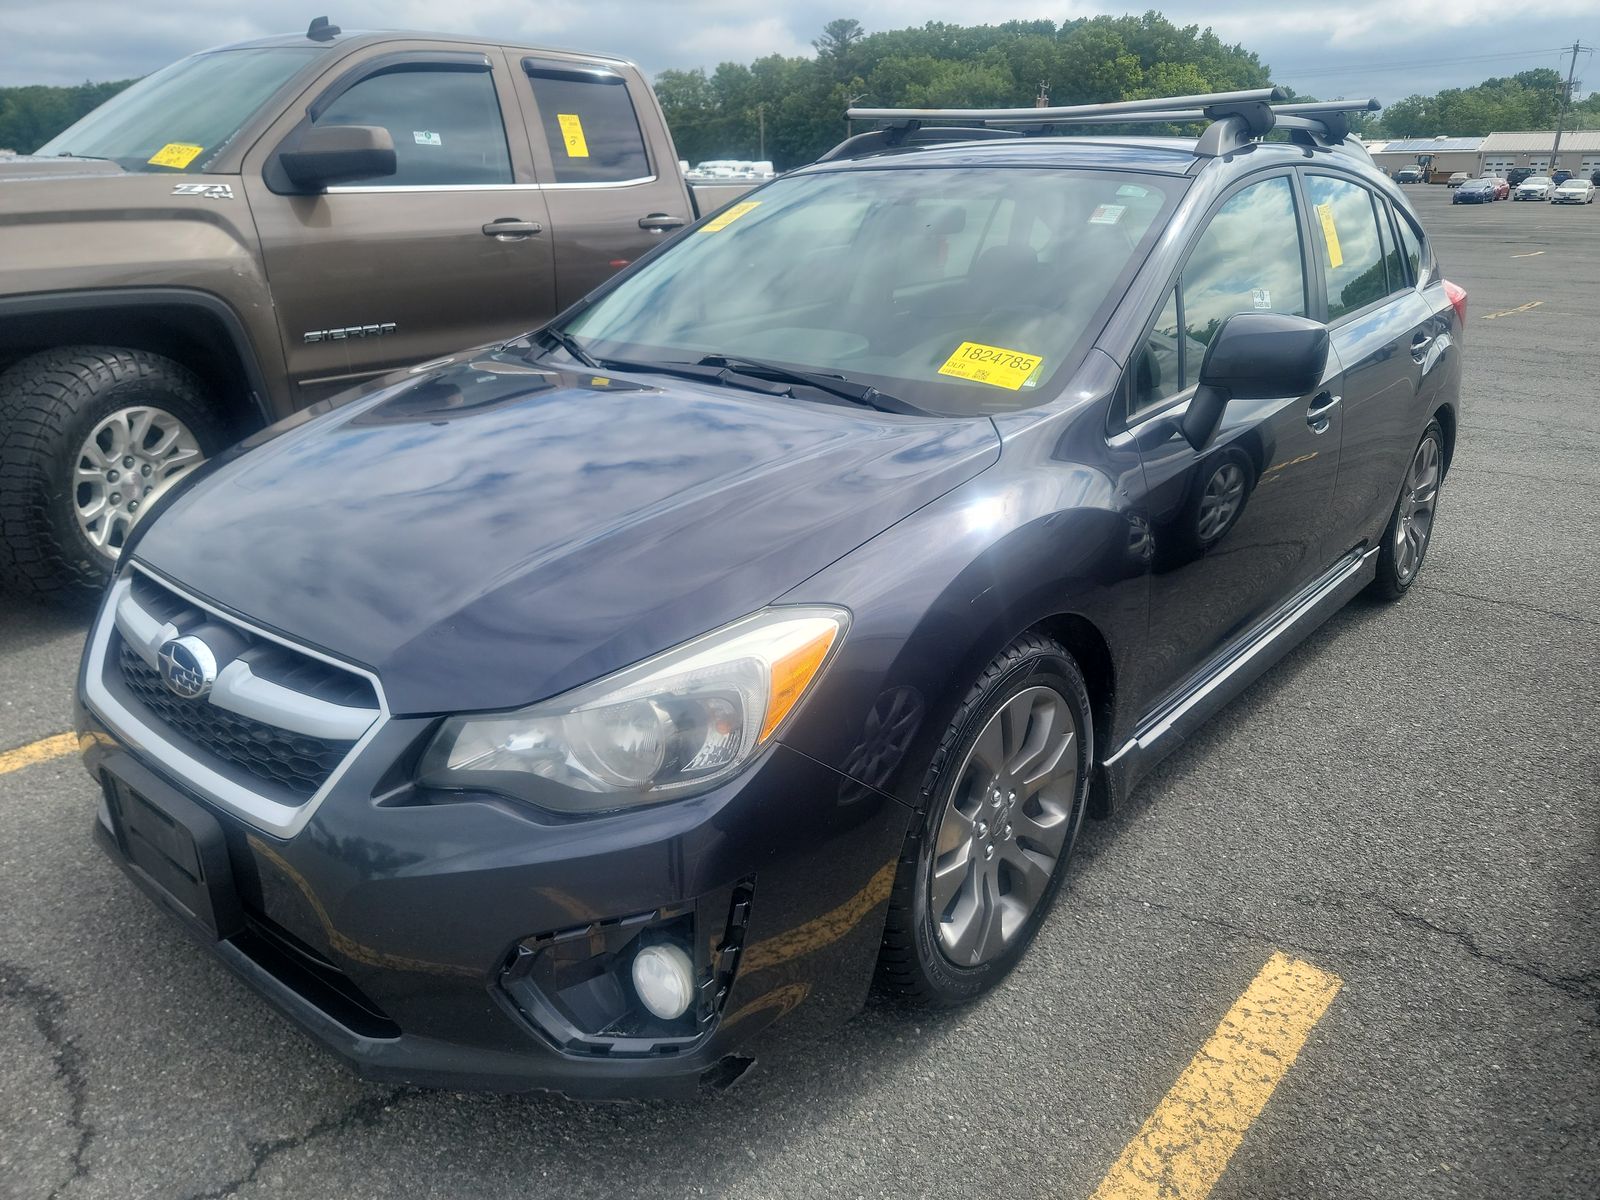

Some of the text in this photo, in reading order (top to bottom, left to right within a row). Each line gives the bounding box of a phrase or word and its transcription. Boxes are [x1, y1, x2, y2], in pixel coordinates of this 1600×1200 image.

[170, 183, 232, 196] Z71
[304, 322, 396, 343] SIERRA
[962, 346, 1035, 371] 1824785
